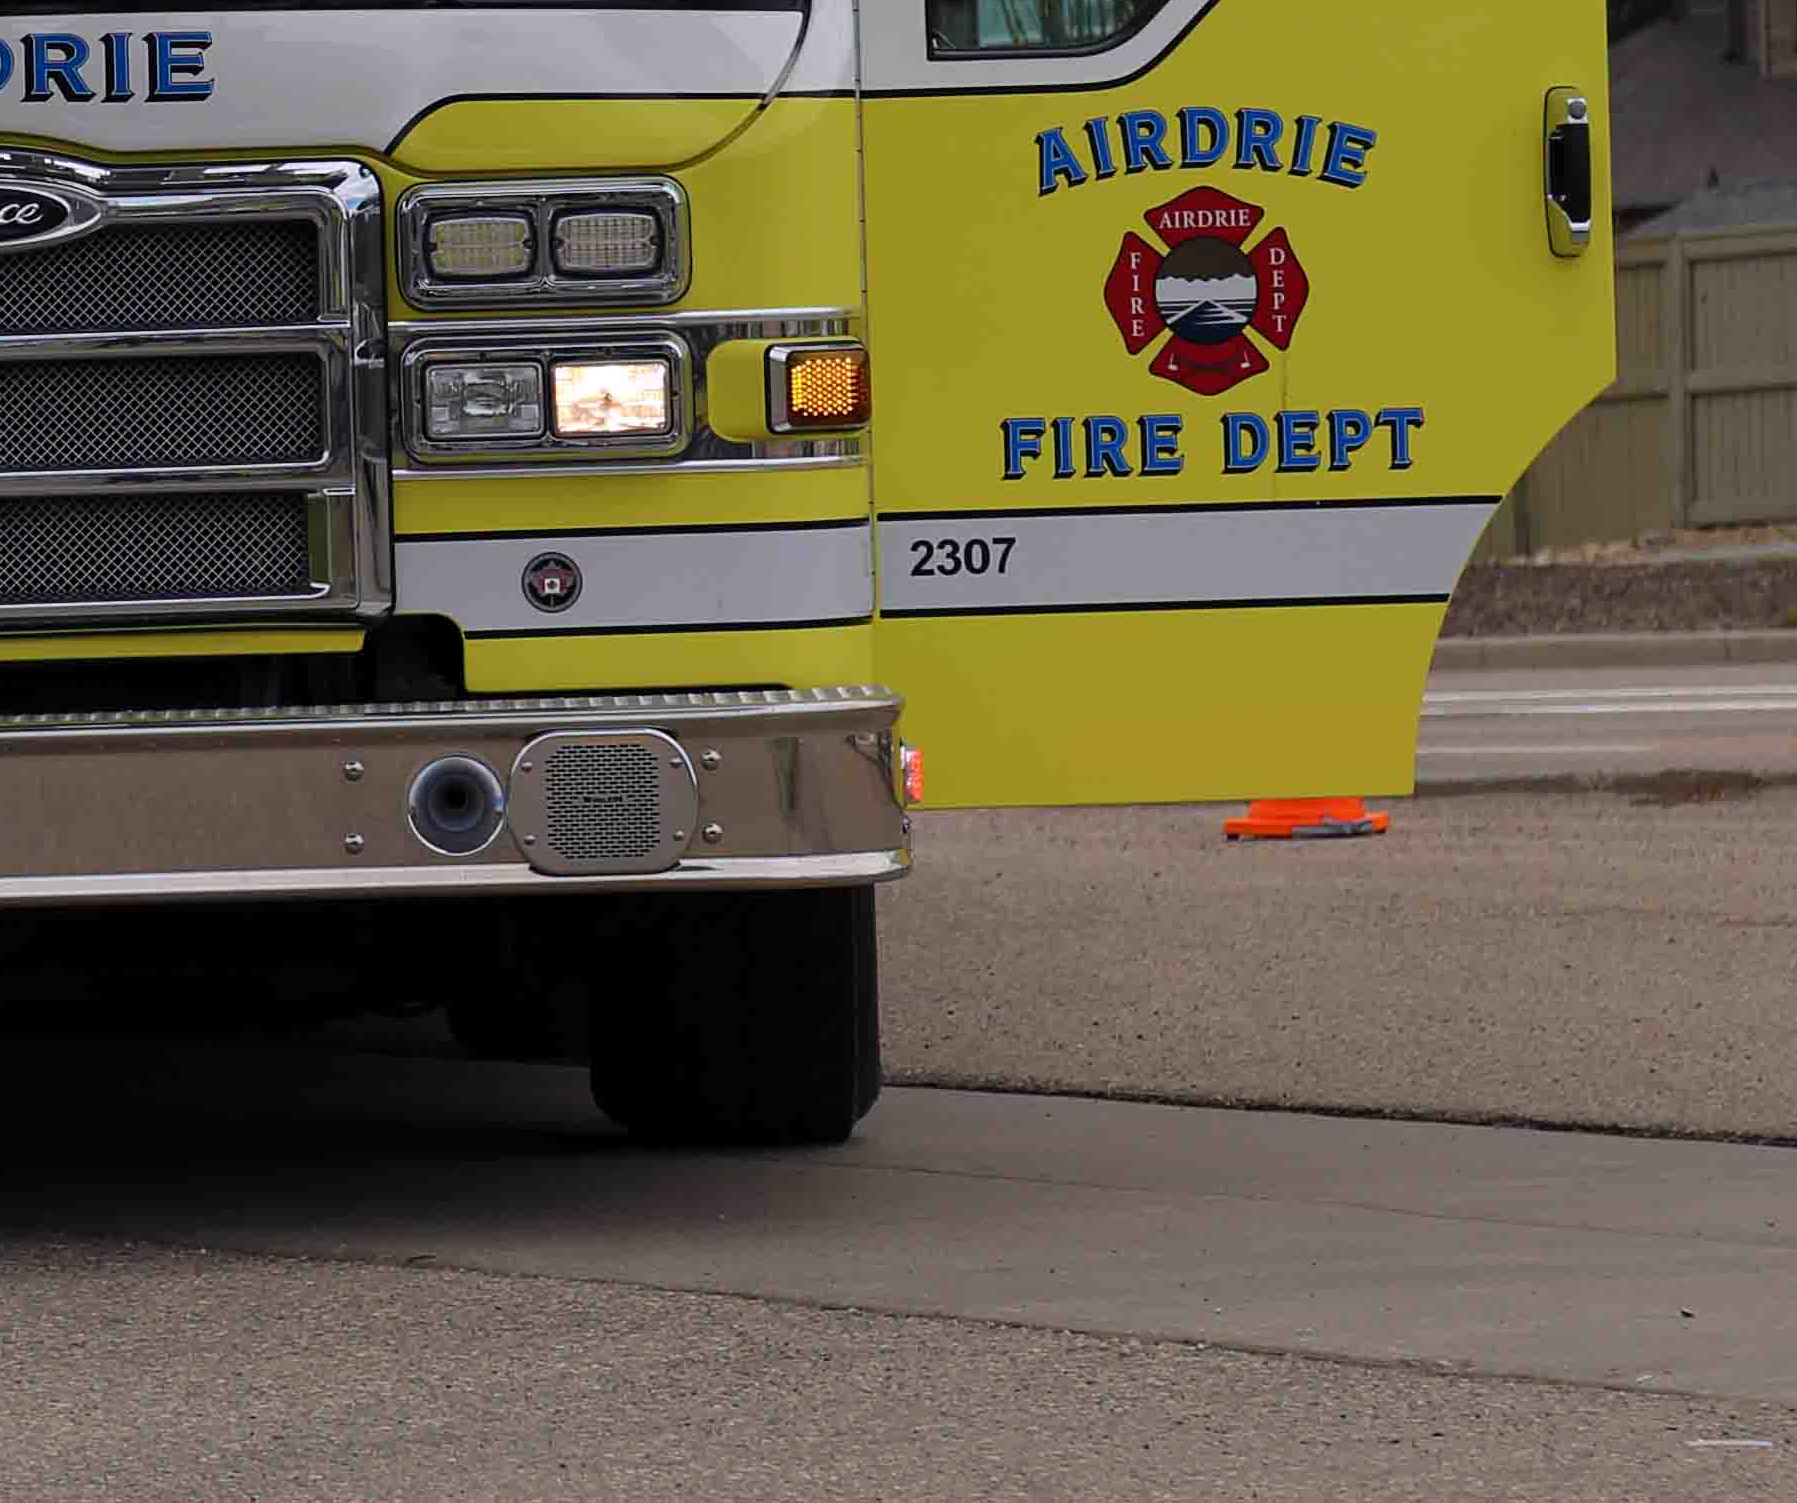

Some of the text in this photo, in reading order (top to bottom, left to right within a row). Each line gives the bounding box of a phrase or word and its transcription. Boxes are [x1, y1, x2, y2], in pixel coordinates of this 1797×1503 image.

[1034, 106, 1378, 197] AIRDRIE
[1159, 208, 1251, 229] AIRDRIE
[1130, 252, 1145, 337] FIRE
[1269, 248, 1287, 333] DEPT
[1000, 407, 1425, 480] FIRE DEPT
[909, 537, 1017, 577] 2307
